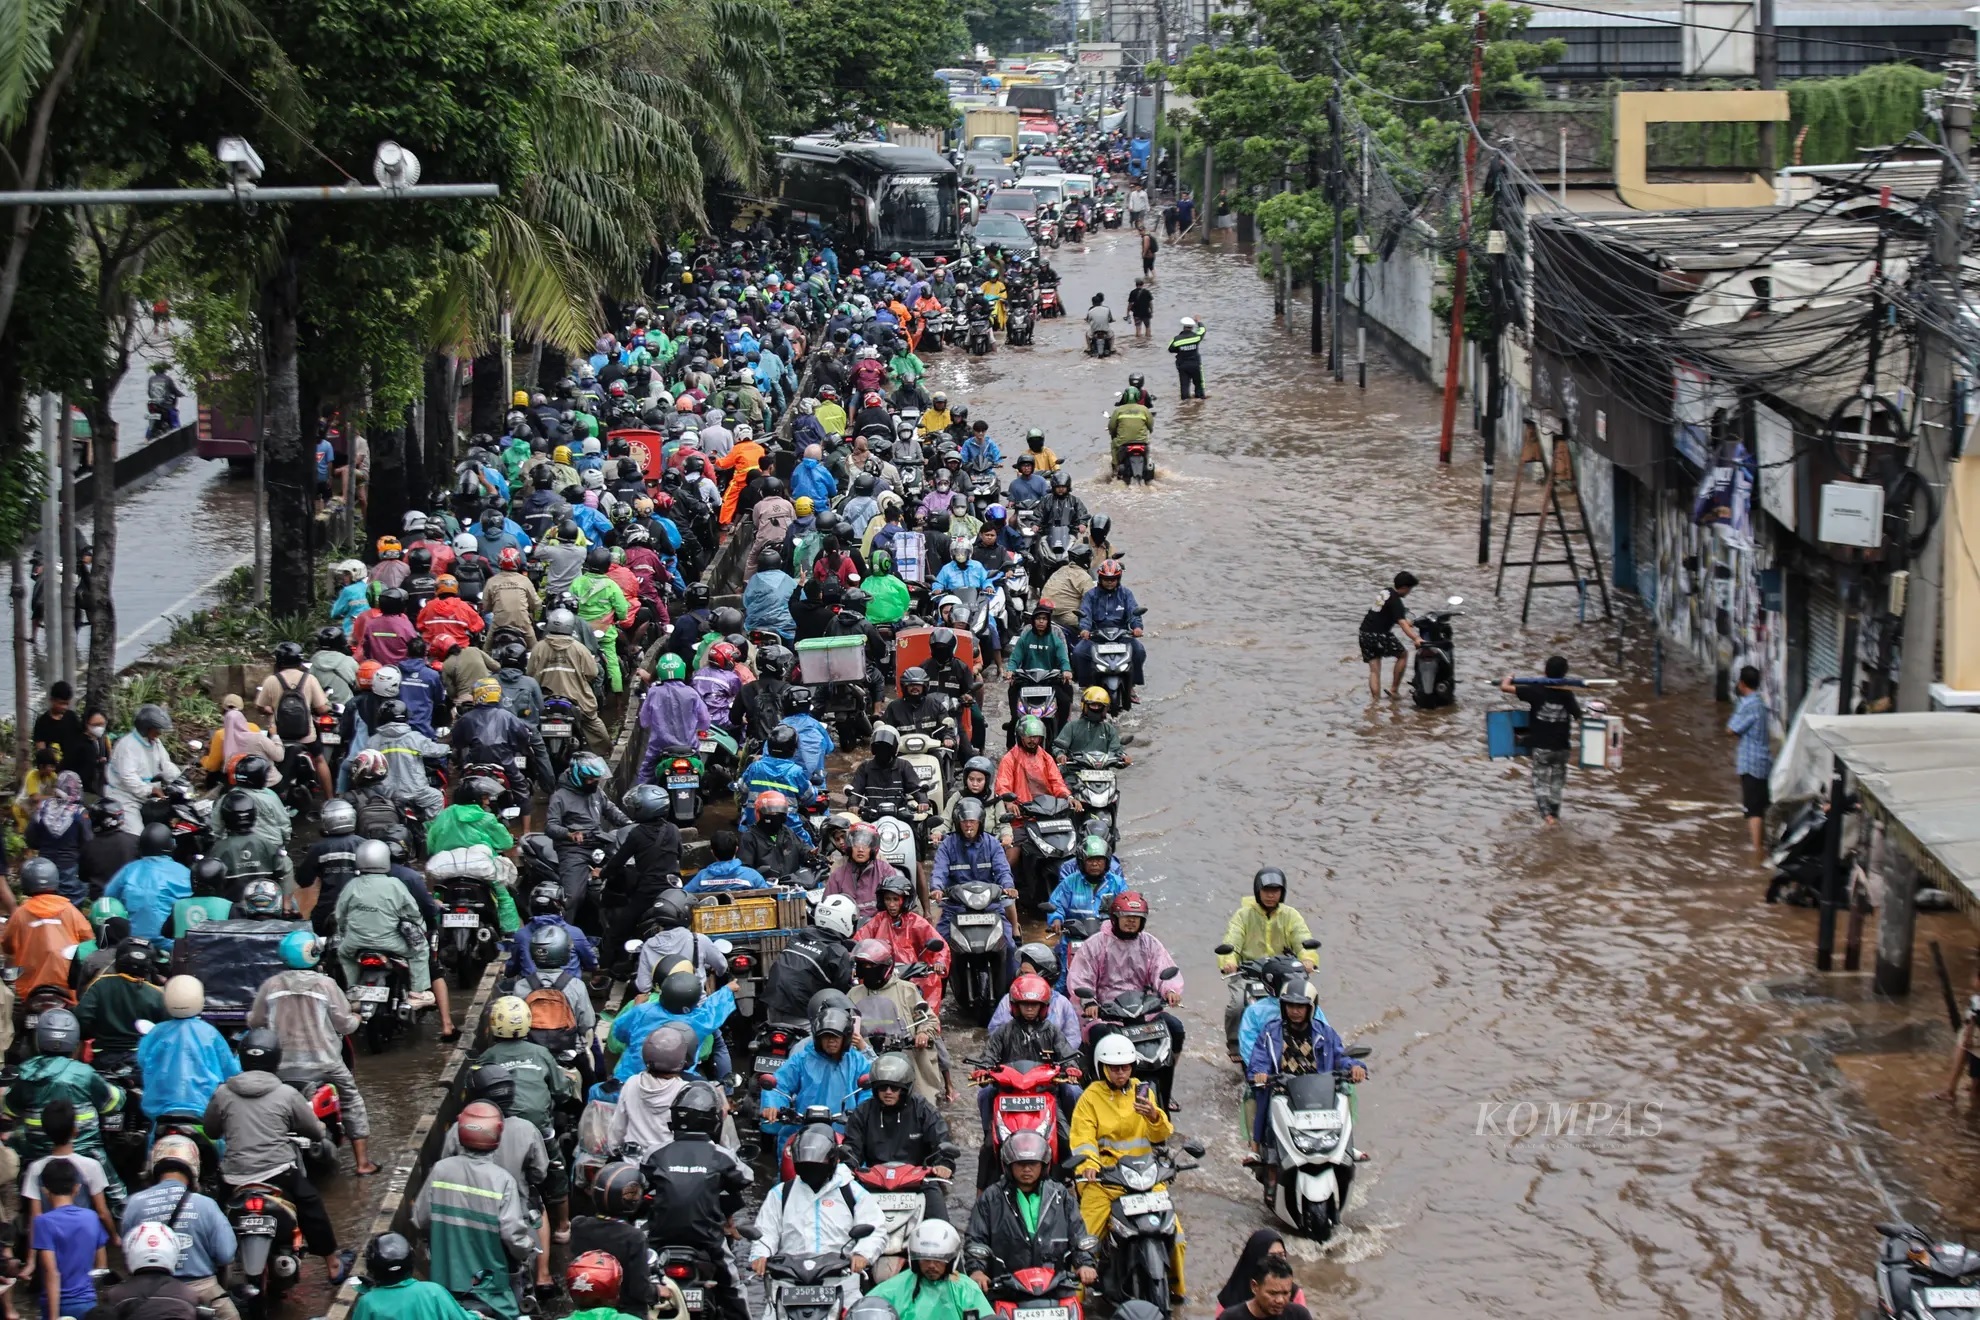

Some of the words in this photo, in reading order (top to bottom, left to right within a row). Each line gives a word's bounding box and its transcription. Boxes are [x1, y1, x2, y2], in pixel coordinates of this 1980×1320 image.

[795, 942, 823, 955] RAINEX
[783, 1288, 789, 1296] B
[795, 1287, 815, 1295] 3505
[1025, 1310, 1045, 1318] 4497
